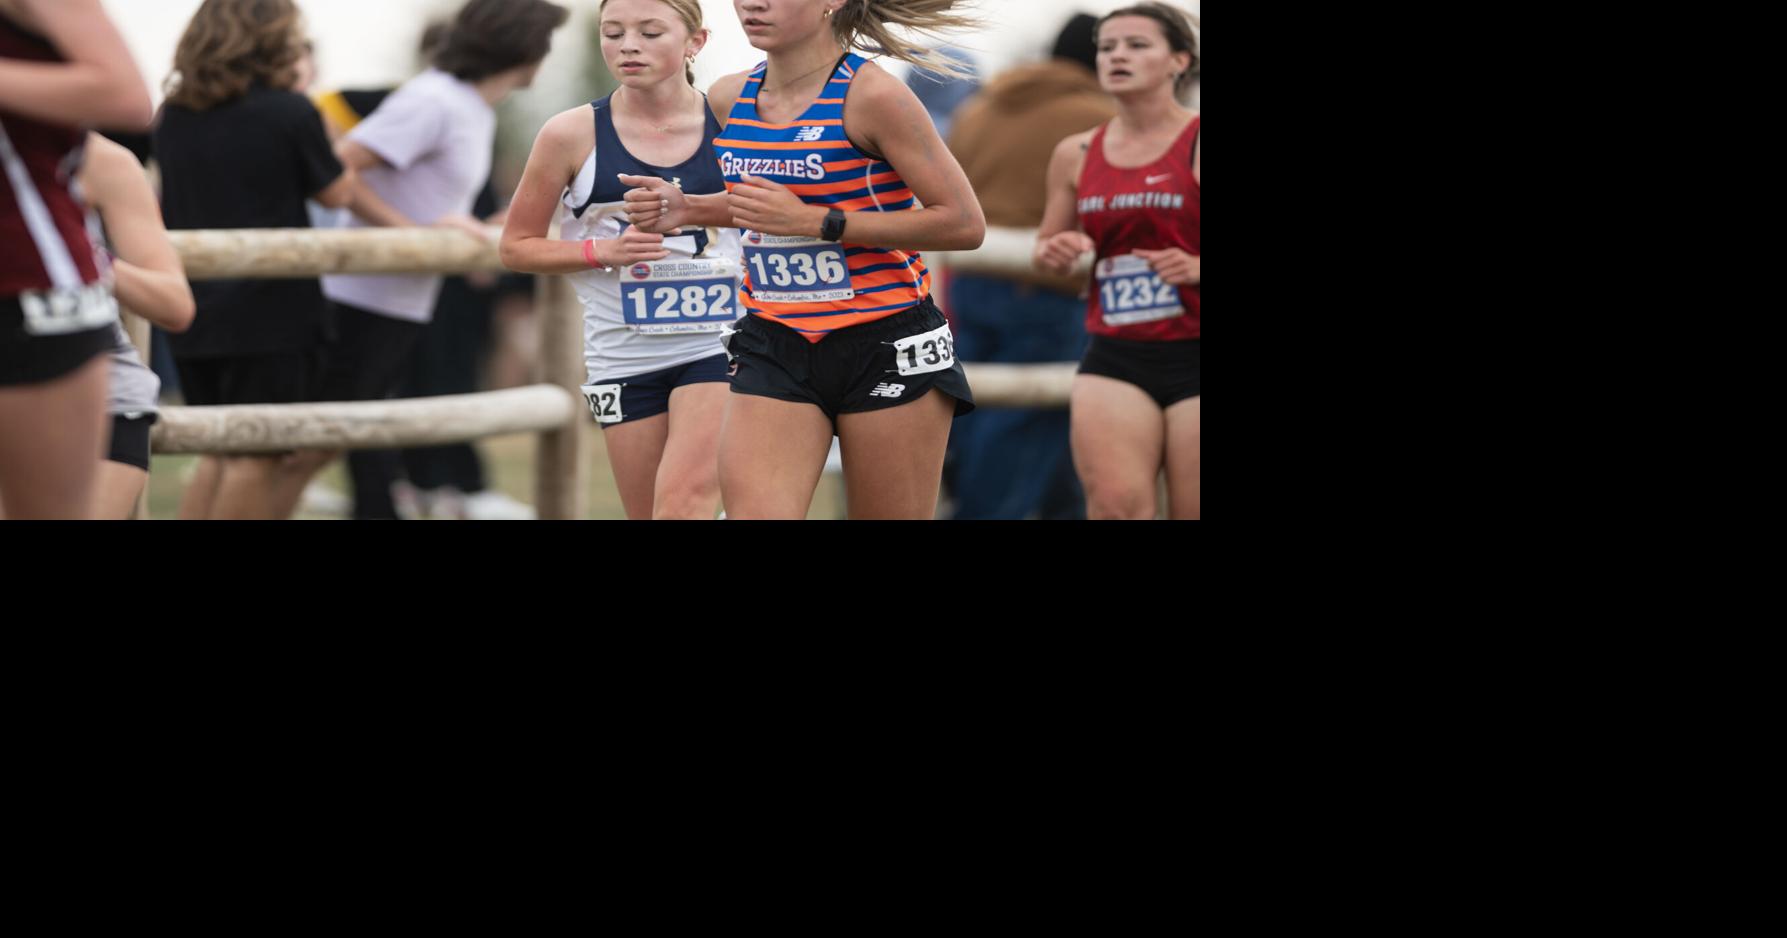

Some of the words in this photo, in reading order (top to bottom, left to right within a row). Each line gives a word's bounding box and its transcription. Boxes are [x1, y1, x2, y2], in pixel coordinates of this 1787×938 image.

[1110, 192, 1183, 209] JUNCTION
[653, 263, 676, 272] CROSS
[750, 250, 845, 286] 1336
[627, 283, 733, 318] 1282
[1102, 276, 1175, 310] 1232
